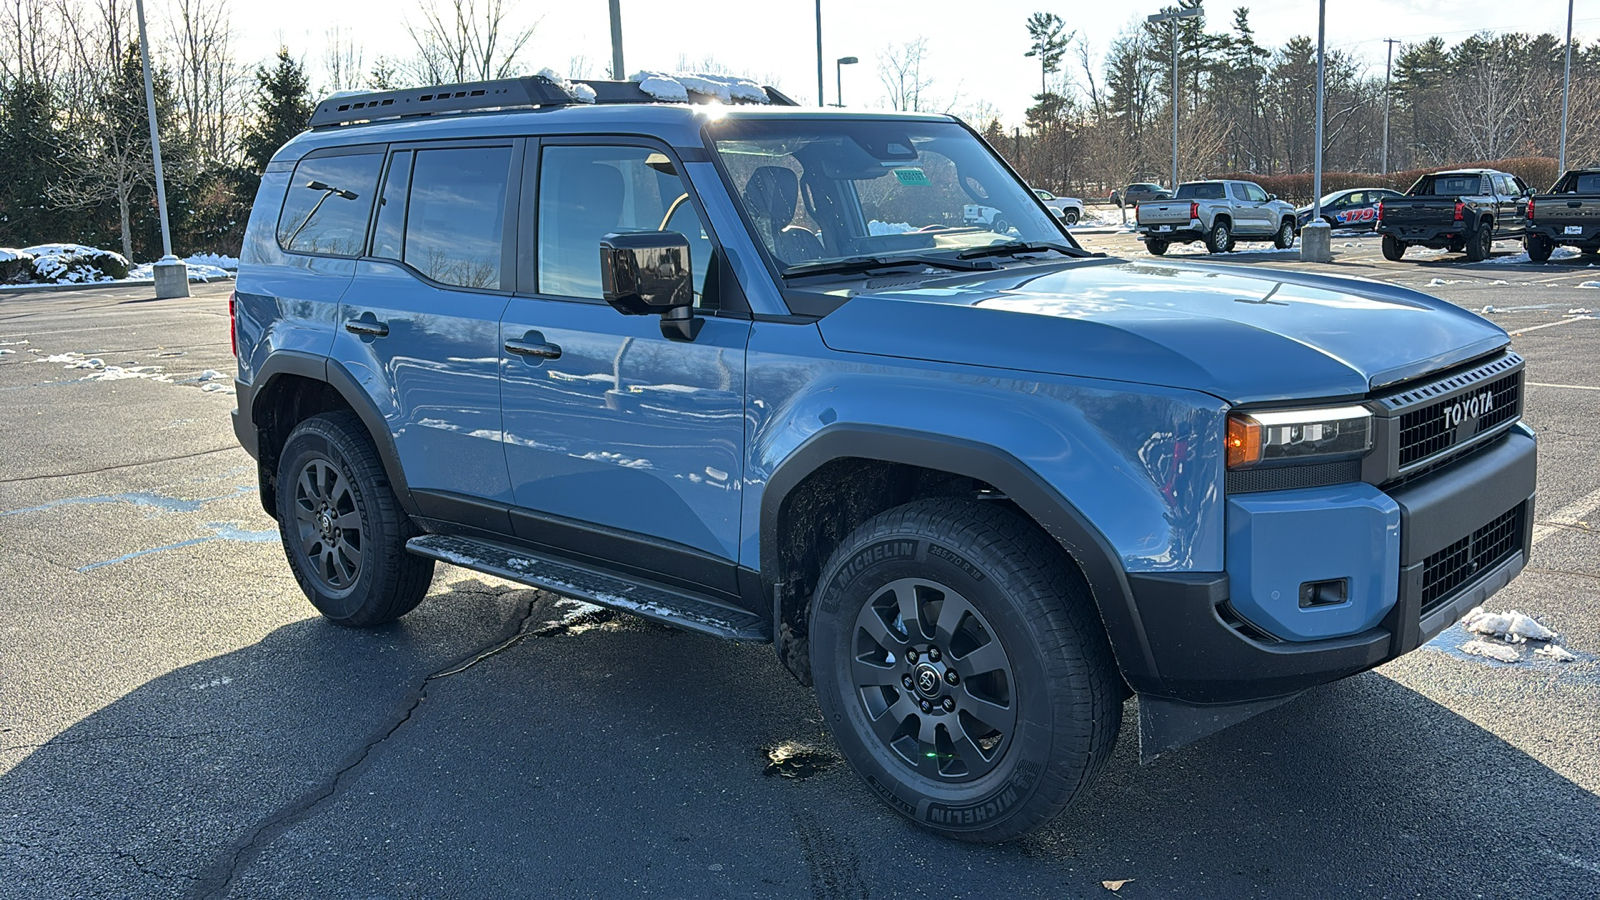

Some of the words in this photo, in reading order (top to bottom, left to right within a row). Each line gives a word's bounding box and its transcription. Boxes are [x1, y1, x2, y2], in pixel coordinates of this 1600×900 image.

[1443, 391, 1493, 429] TOYOTA
[343, 465, 370, 537] MICHELIN
[837, 542, 914, 585] MICHELIN
[930, 546, 961, 566] 265/70
[962, 562, 971, 571] R
[970, 569, 982, 580] 18
[931, 788, 1018, 824] MICHELIN
